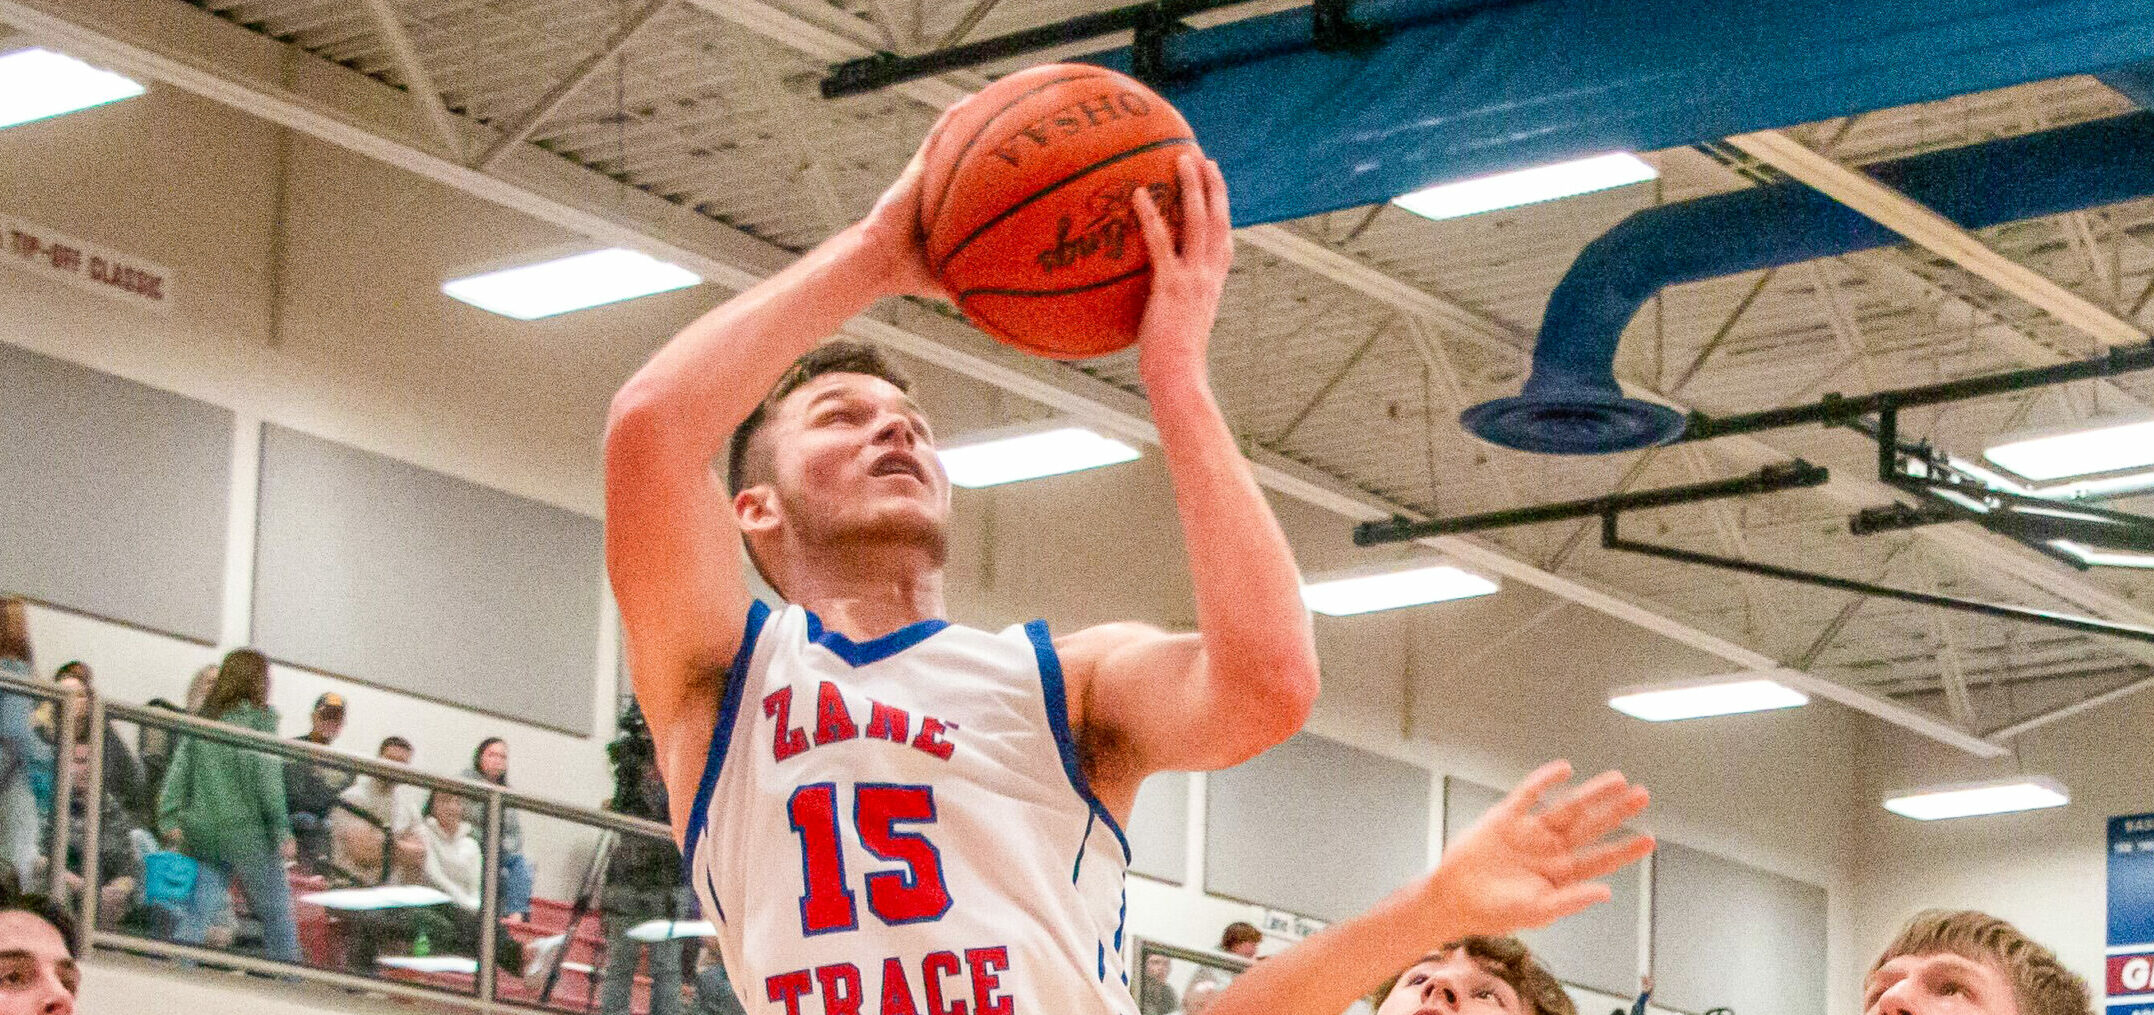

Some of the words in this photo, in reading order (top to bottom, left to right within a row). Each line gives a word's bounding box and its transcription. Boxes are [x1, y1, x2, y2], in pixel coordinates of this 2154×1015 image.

[988, 92, 1150, 167] OHSAA
[762, 680, 959, 763] ZANE
[787, 782, 954, 938] 15
[765, 945, 1015, 1015] TRACE
